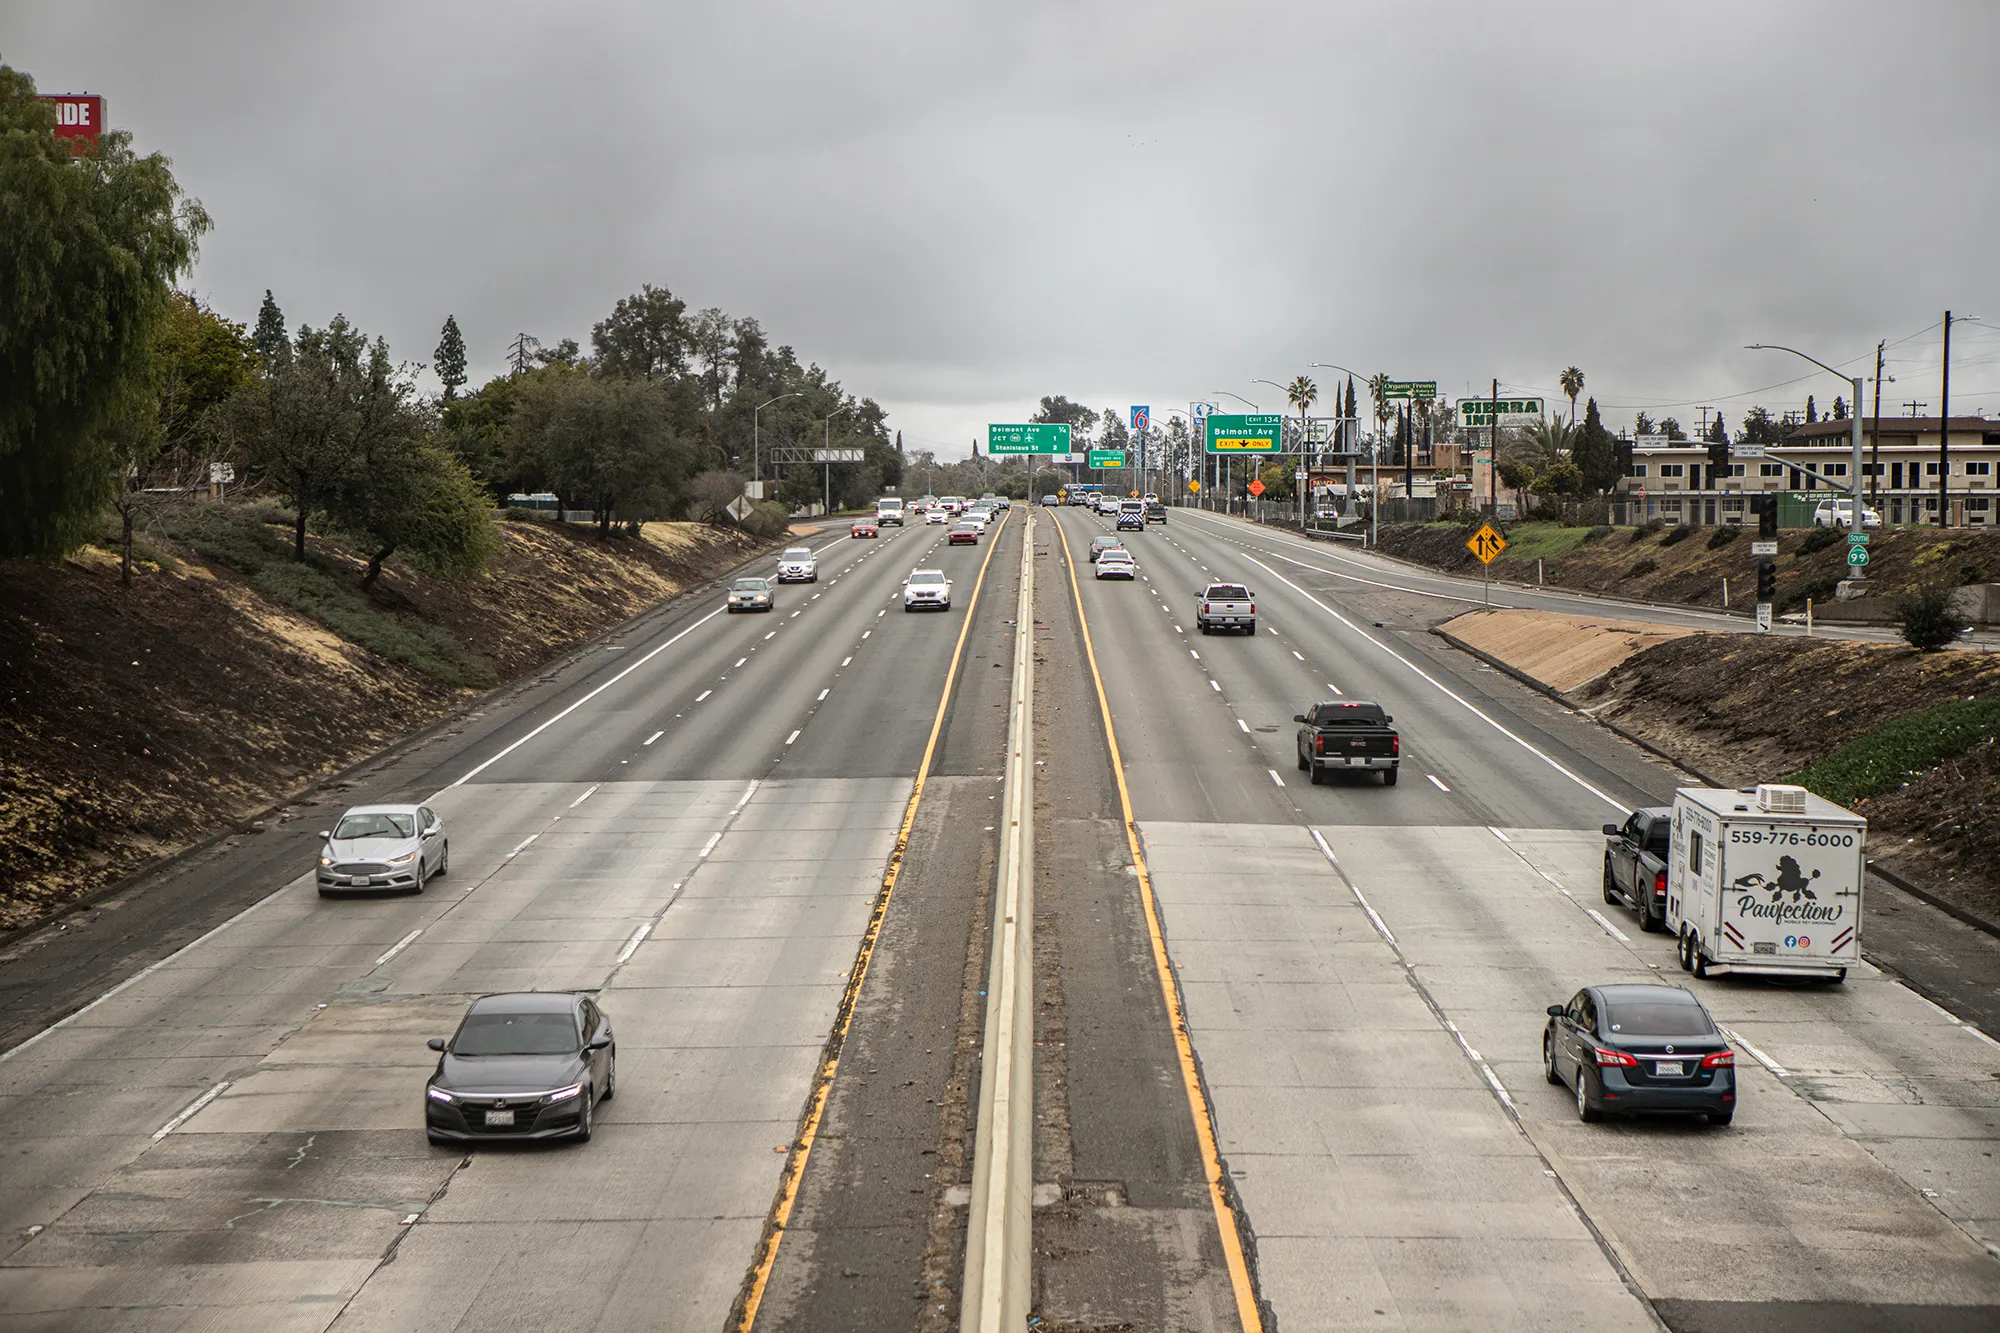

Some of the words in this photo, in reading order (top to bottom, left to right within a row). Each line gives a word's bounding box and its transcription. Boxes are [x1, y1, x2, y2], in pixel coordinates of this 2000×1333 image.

[1462, 401, 1538, 414] SIERRA
[1134, 408, 1148, 430] 6
[1851, 554, 1866, 562] 99
[1731, 831, 1853, 847] 559-776-6000
[1737, 895, 1843, 925] Pawfection
